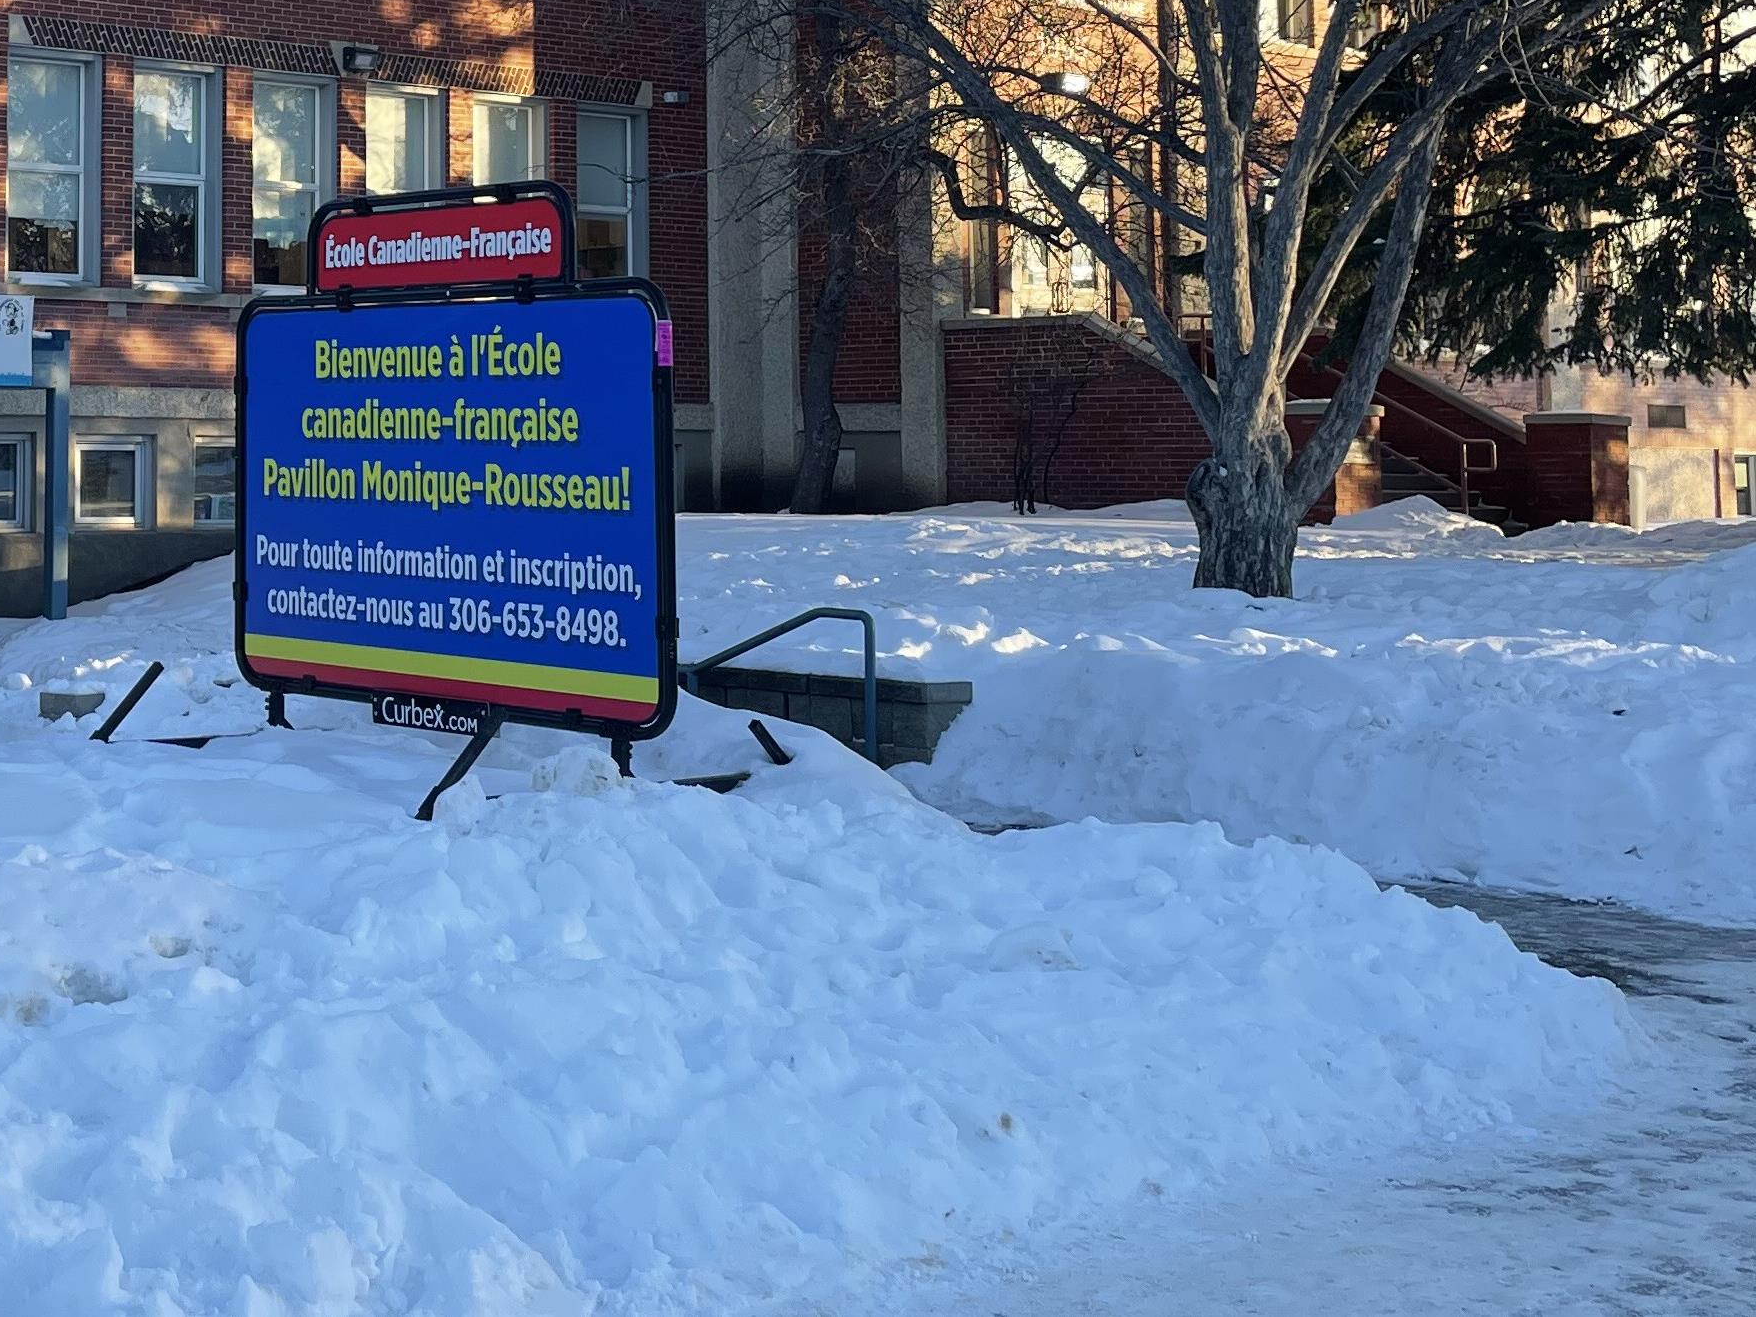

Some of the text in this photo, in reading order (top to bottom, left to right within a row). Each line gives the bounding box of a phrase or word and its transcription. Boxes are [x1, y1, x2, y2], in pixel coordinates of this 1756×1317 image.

[325, 222, 552, 269] École Canadienne-Française
[315, 325, 562, 379] Bienvenue à l'École
[302, 397, 579, 448] canadienne-française
[263, 458, 631, 511] Pavillon Monique-Rousseau!
[256, 534, 642, 601] Pour toute information et inscription,
[267, 586, 628, 648] contactez-nous au 306-653-8498.
